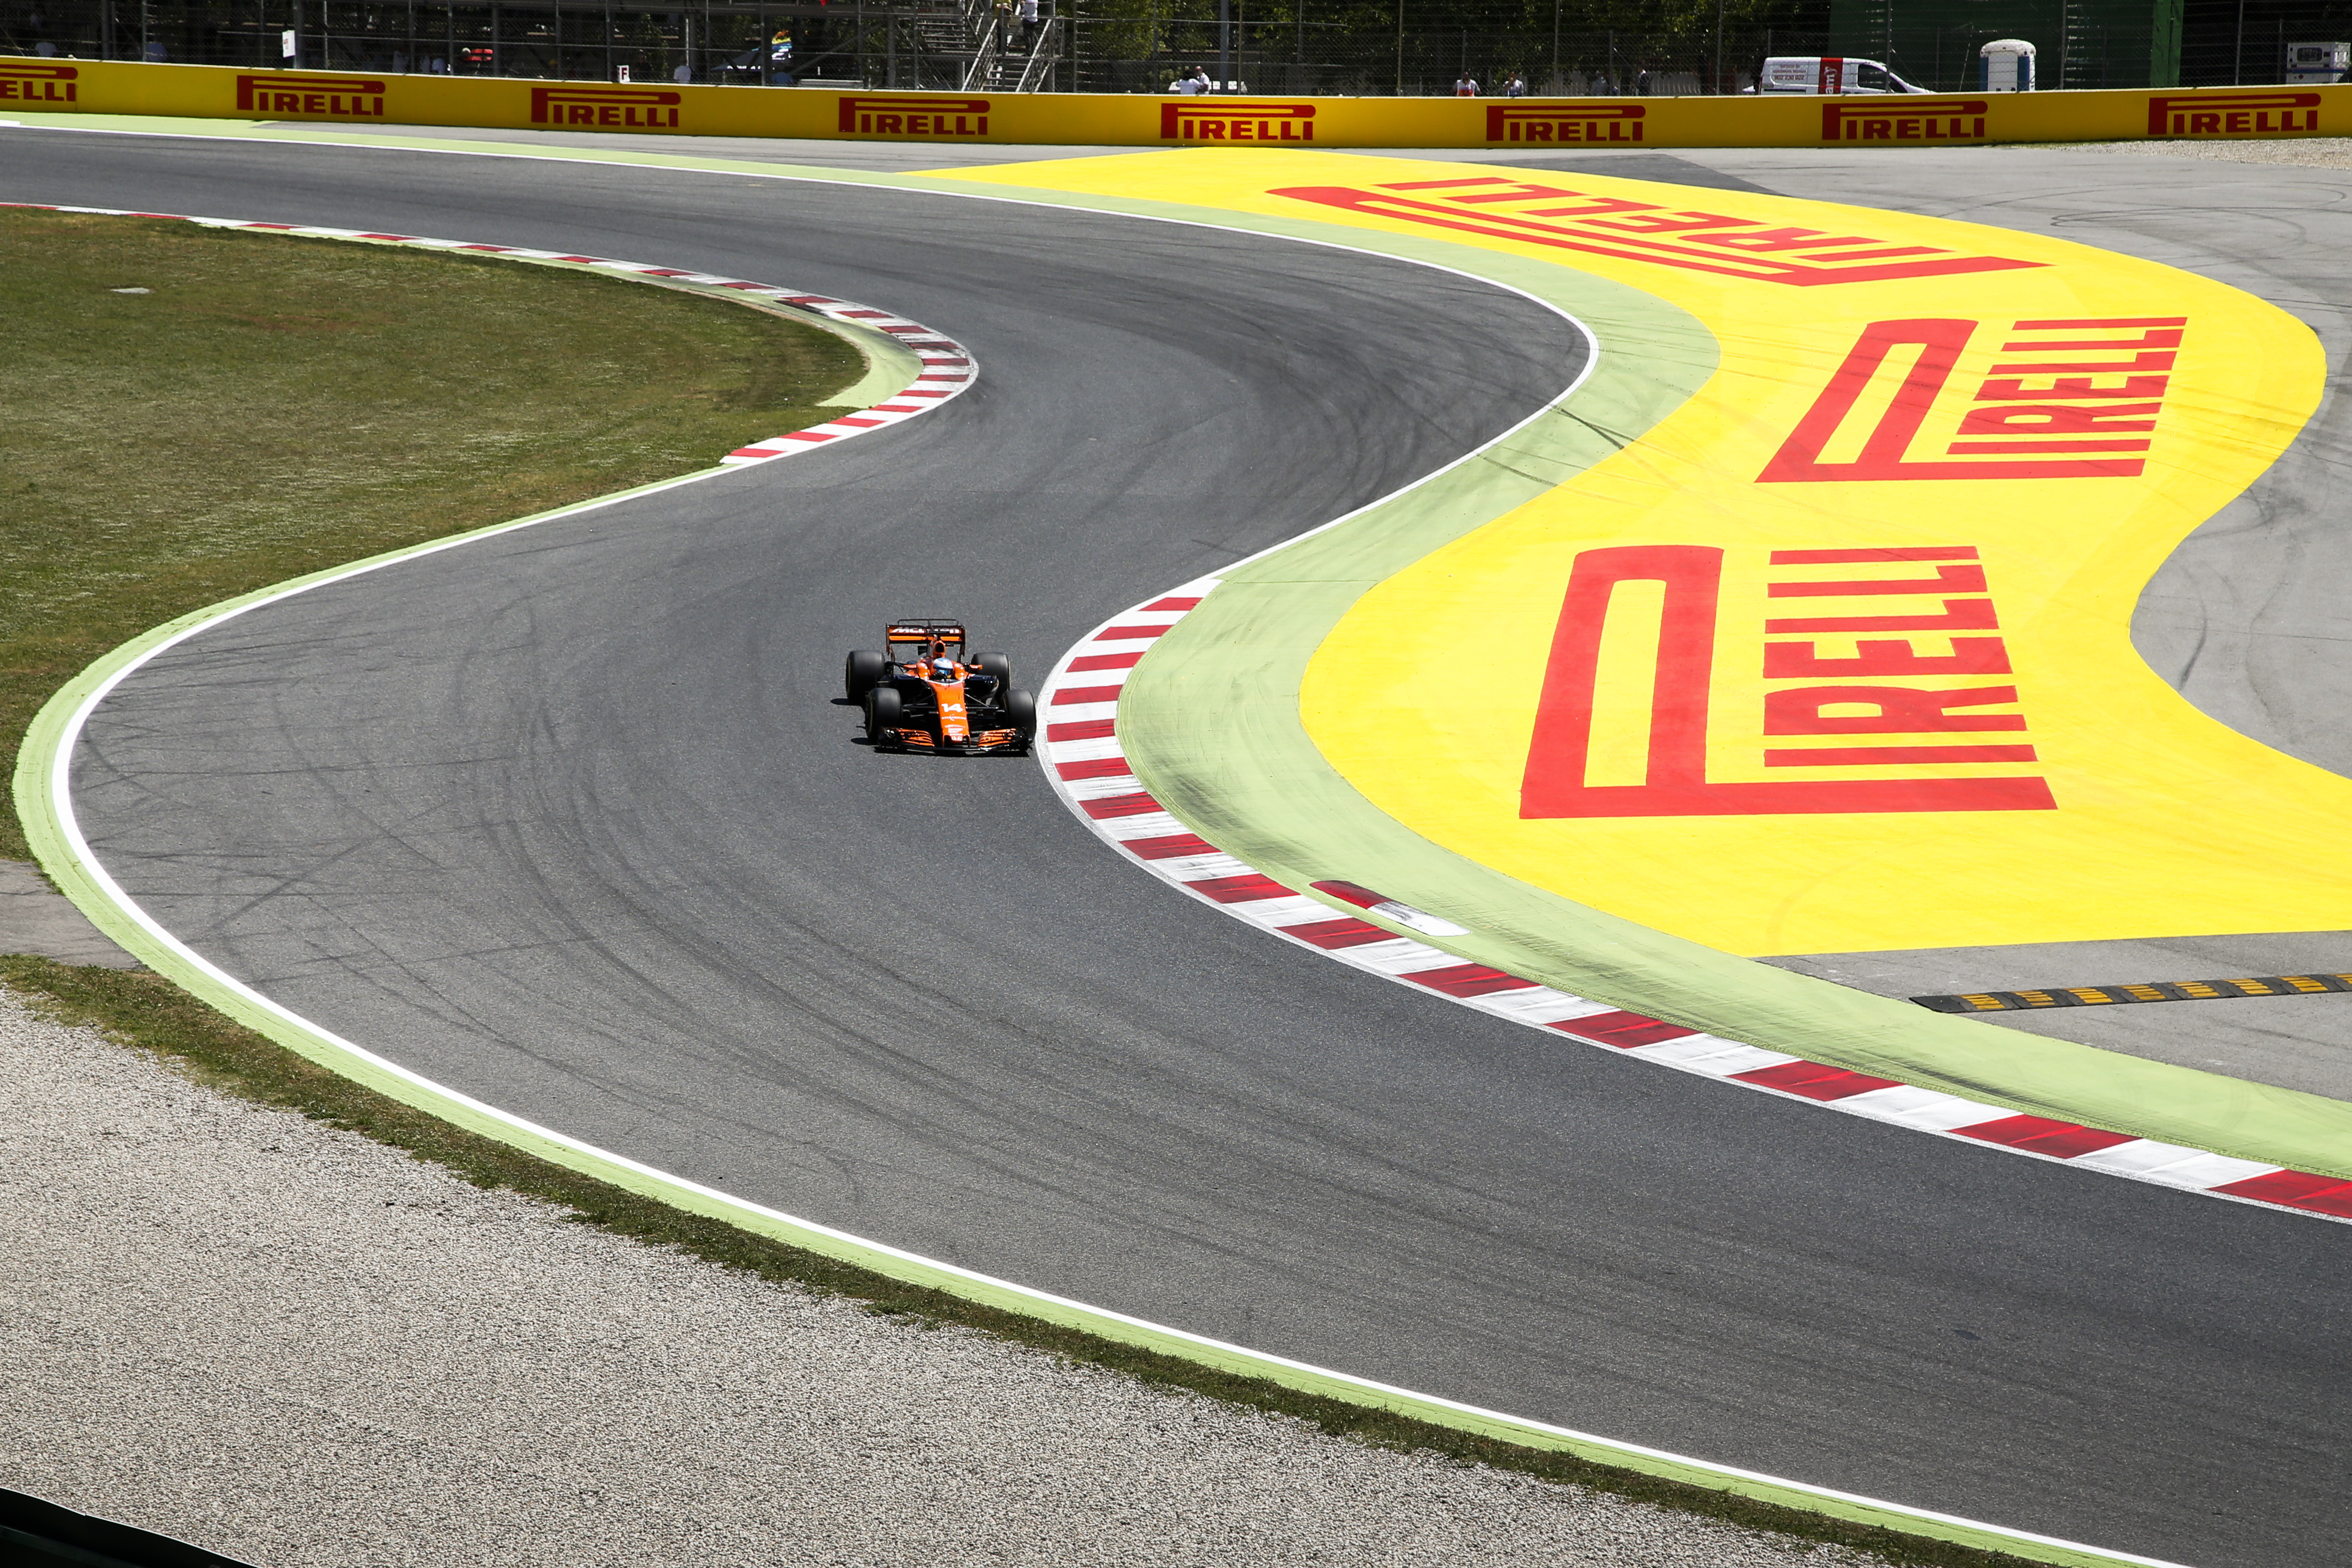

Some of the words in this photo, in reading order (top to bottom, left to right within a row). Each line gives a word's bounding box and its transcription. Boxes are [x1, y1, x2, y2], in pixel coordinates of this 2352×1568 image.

[0, 64, 78, 102] ELLI
[621, 67, 628, 80] F
[237, 75, 386, 115] PIRELLI
[531, 87, 681, 127] PIRELLI
[2149, 93, 2322, 134] PIRELLI
[839, 97, 991, 135] PIRELLI
[1161, 103, 1316, 140] PIRELLI
[1486, 105, 1647, 141] PIRELLI
[1823, 101, 1988, 139] PIRELLI
[1266, 178, 2050, 286] PIRELLI
[1755, 318, 2187, 482] PIRELLI
[1520, 545, 2057, 819] PIRELLI
[941, 703, 963, 713] 14
